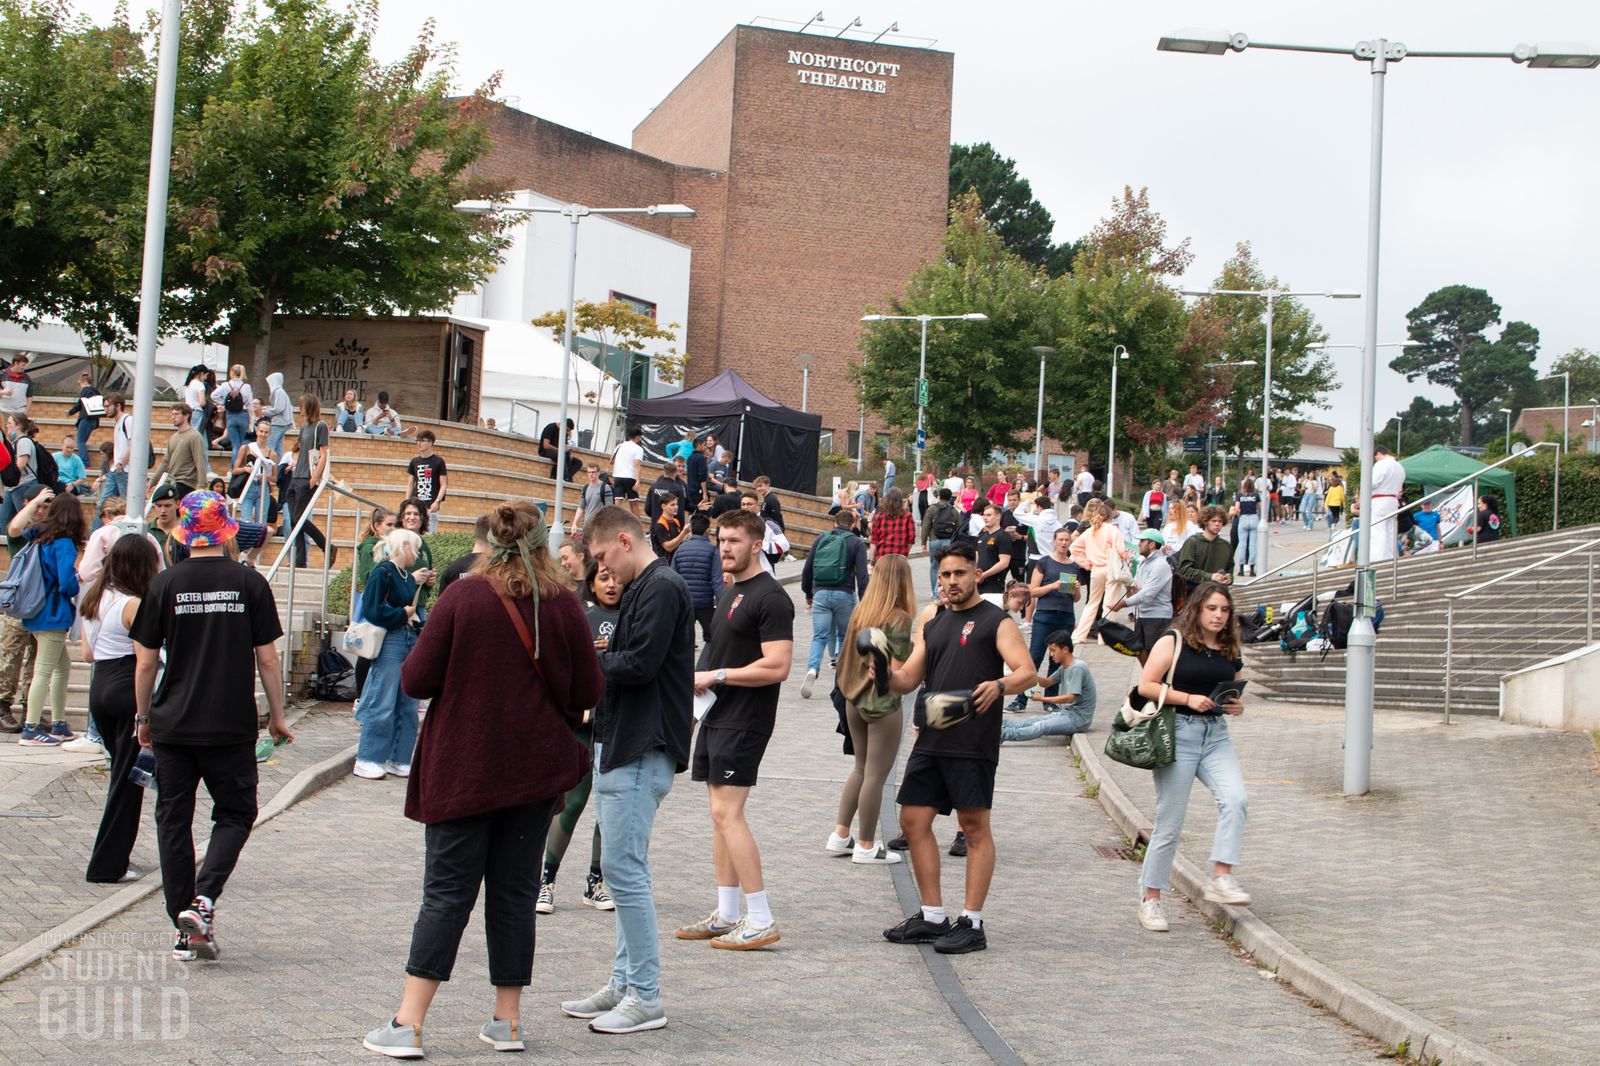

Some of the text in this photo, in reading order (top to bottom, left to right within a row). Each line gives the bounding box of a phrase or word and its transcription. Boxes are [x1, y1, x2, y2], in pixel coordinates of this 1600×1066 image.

[787, 50, 900, 77] NORTHCOTT
[797, 69, 886, 93] THEATRE
[299, 354, 358, 379] FLAVOUR
[176, 591, 240, 603] EXETER UNIVERSITY
[204, 603, 227, 613] BOXING
[227, 603, 245, 613] CLUB
